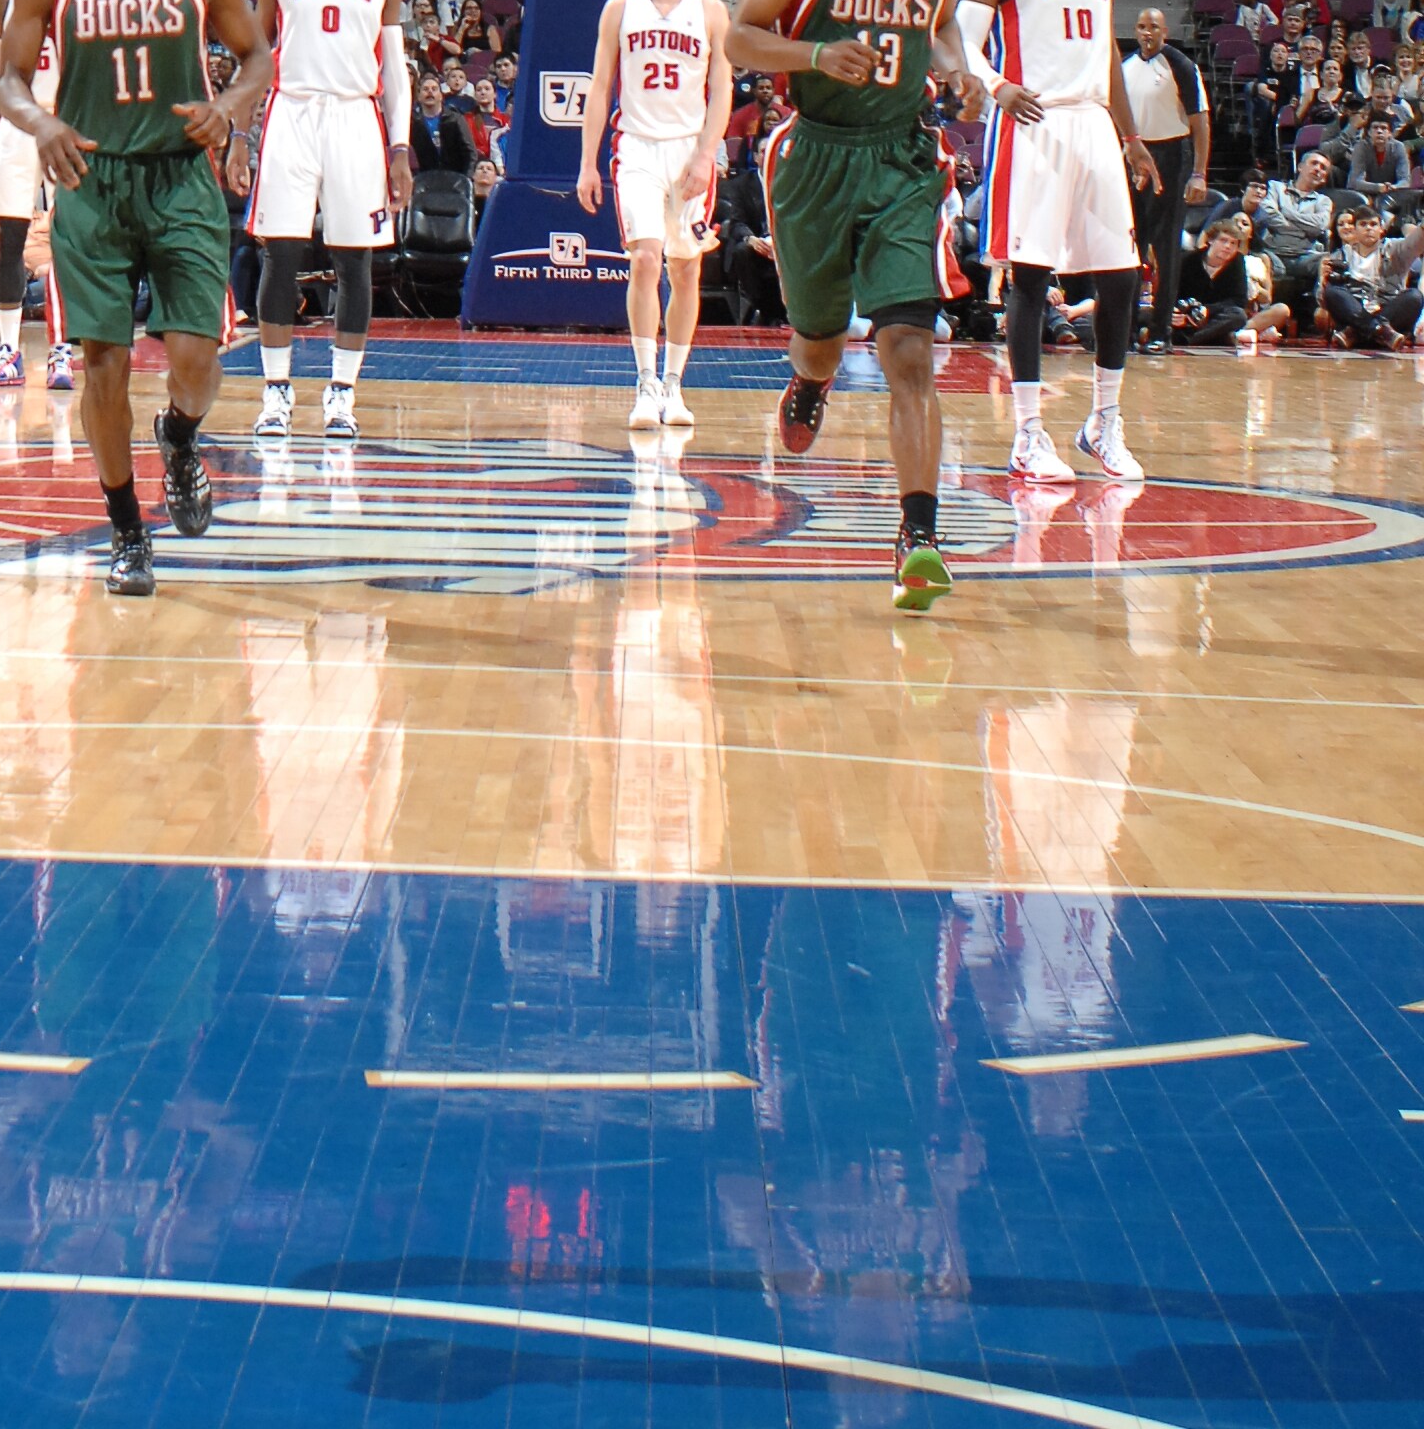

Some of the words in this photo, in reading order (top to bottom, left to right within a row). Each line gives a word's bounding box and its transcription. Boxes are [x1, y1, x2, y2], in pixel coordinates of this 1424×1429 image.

[321, 5, 340, 33] 0
[1063, 7, 1093, 41] 10
[627, 29, 701, 58] PISTONS
[112, 45, 155, 103] 11
[643, 62, 679, 90] 25
[494, 265, 537, 279] FIFTH
[542, 266, 592, 280] THIRD
[597, 267, 630, 281] BAN
